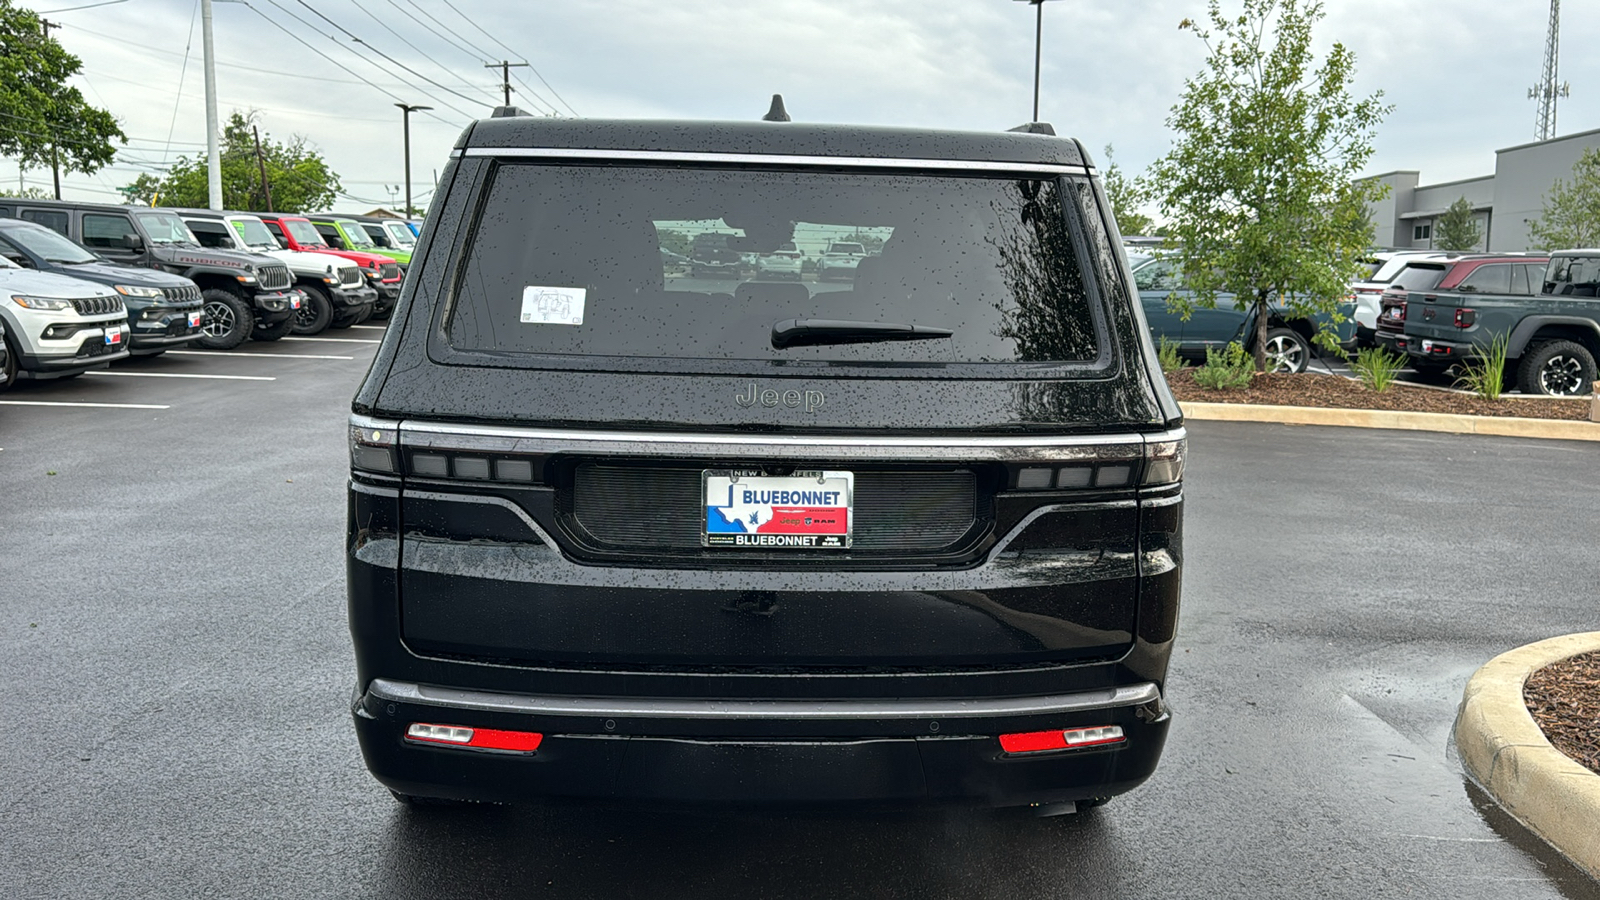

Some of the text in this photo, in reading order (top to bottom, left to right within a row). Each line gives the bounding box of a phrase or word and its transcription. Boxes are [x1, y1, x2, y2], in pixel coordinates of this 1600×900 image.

[180, 257, 241, 267] RUBICON
[735, 383, 825, 413] Jeep
[761, 470, 822, 478] BNFELS
[743, 490, 840, 505] BLUEBONNET
[780, 517, 801, 526] Jeep
[736, 535, 818, 546] BLUEBONNET
